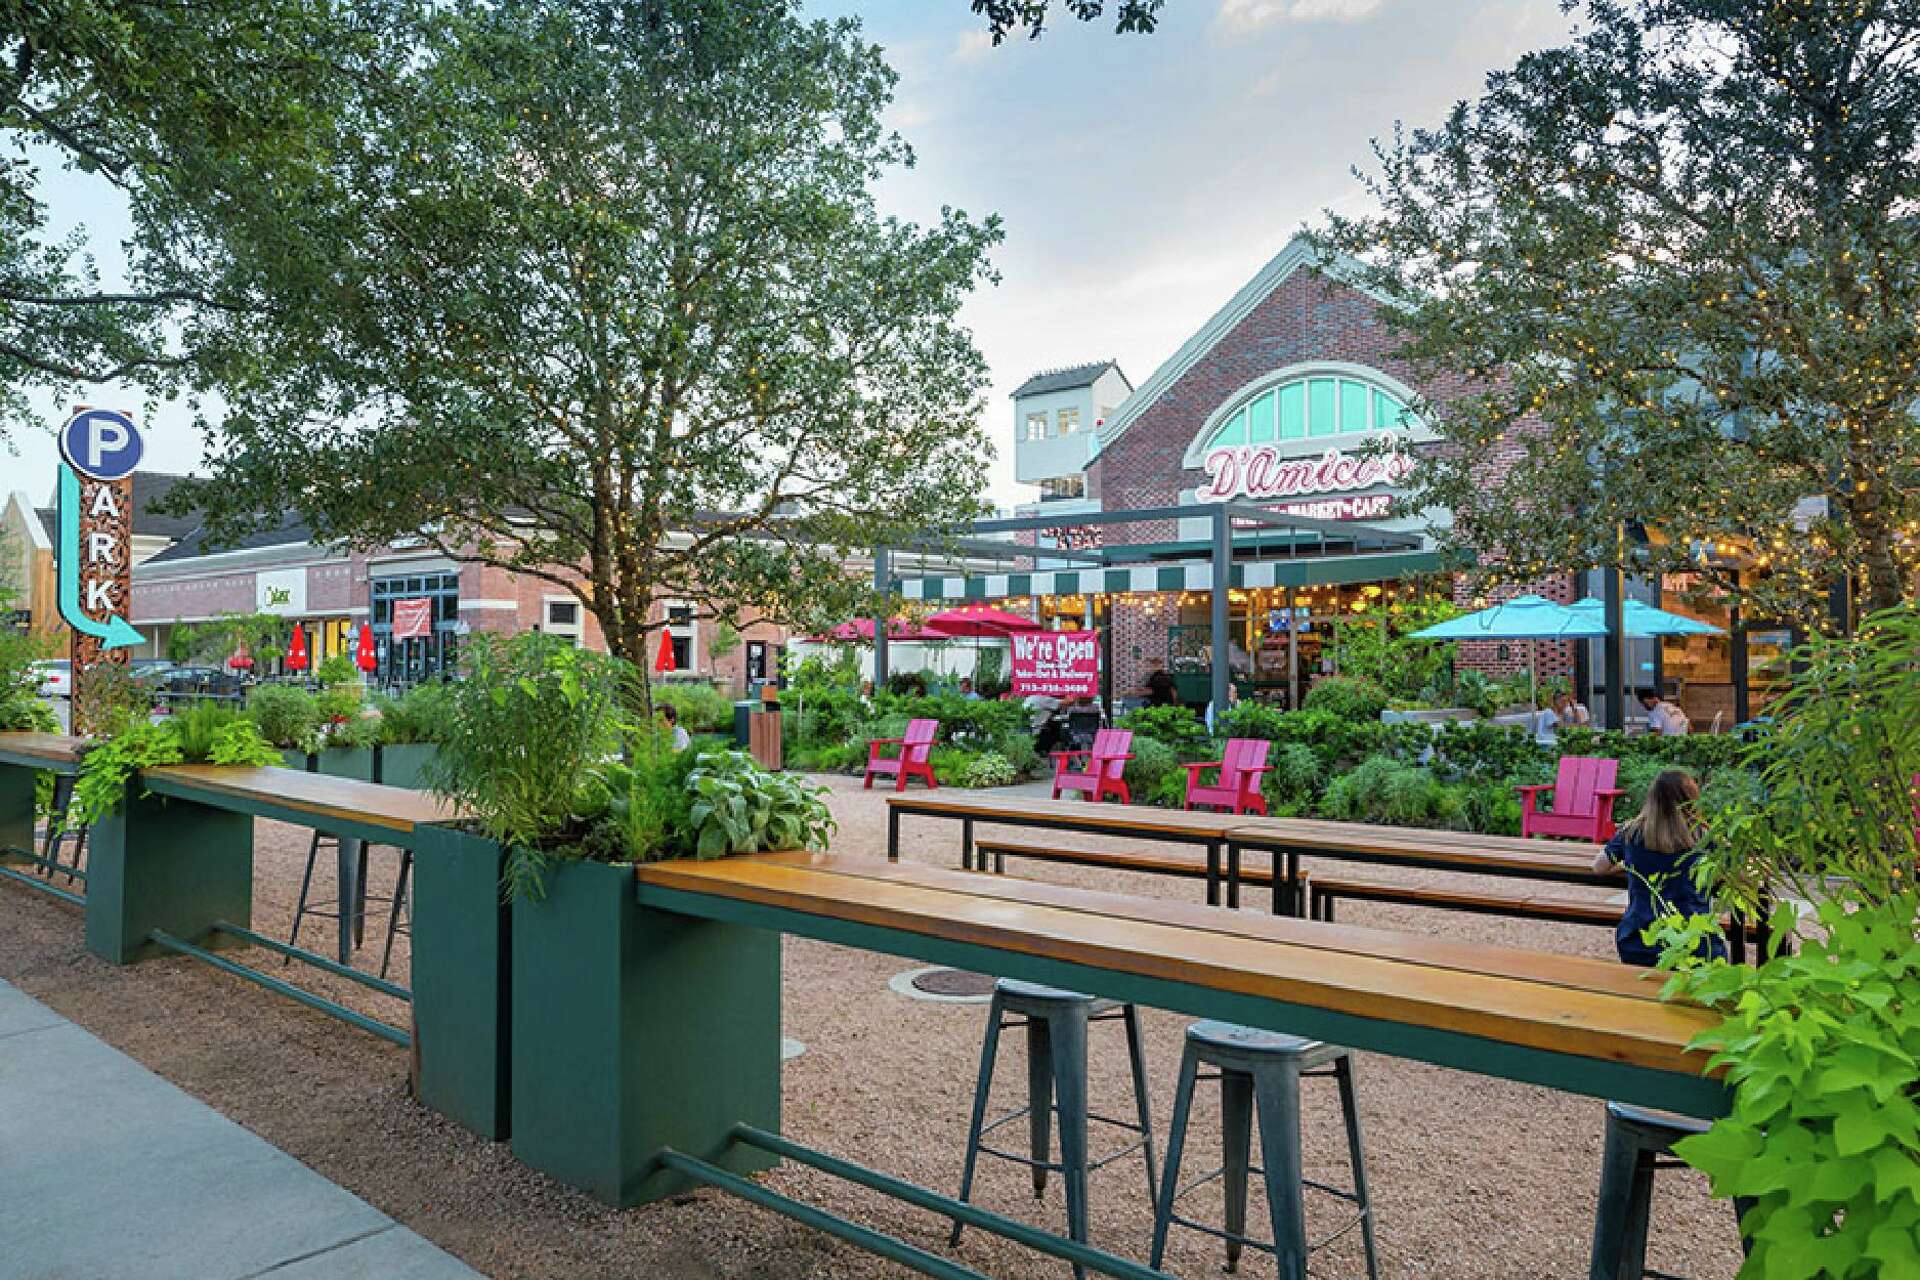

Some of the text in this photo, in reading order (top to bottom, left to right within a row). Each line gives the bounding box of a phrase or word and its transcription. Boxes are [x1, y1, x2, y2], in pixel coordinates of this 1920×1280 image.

[1197, 432, 1415, 501] D'Amico's
[88, 418, 130, 610] PARK
[1014, 635, 1095, 666] We're Open
